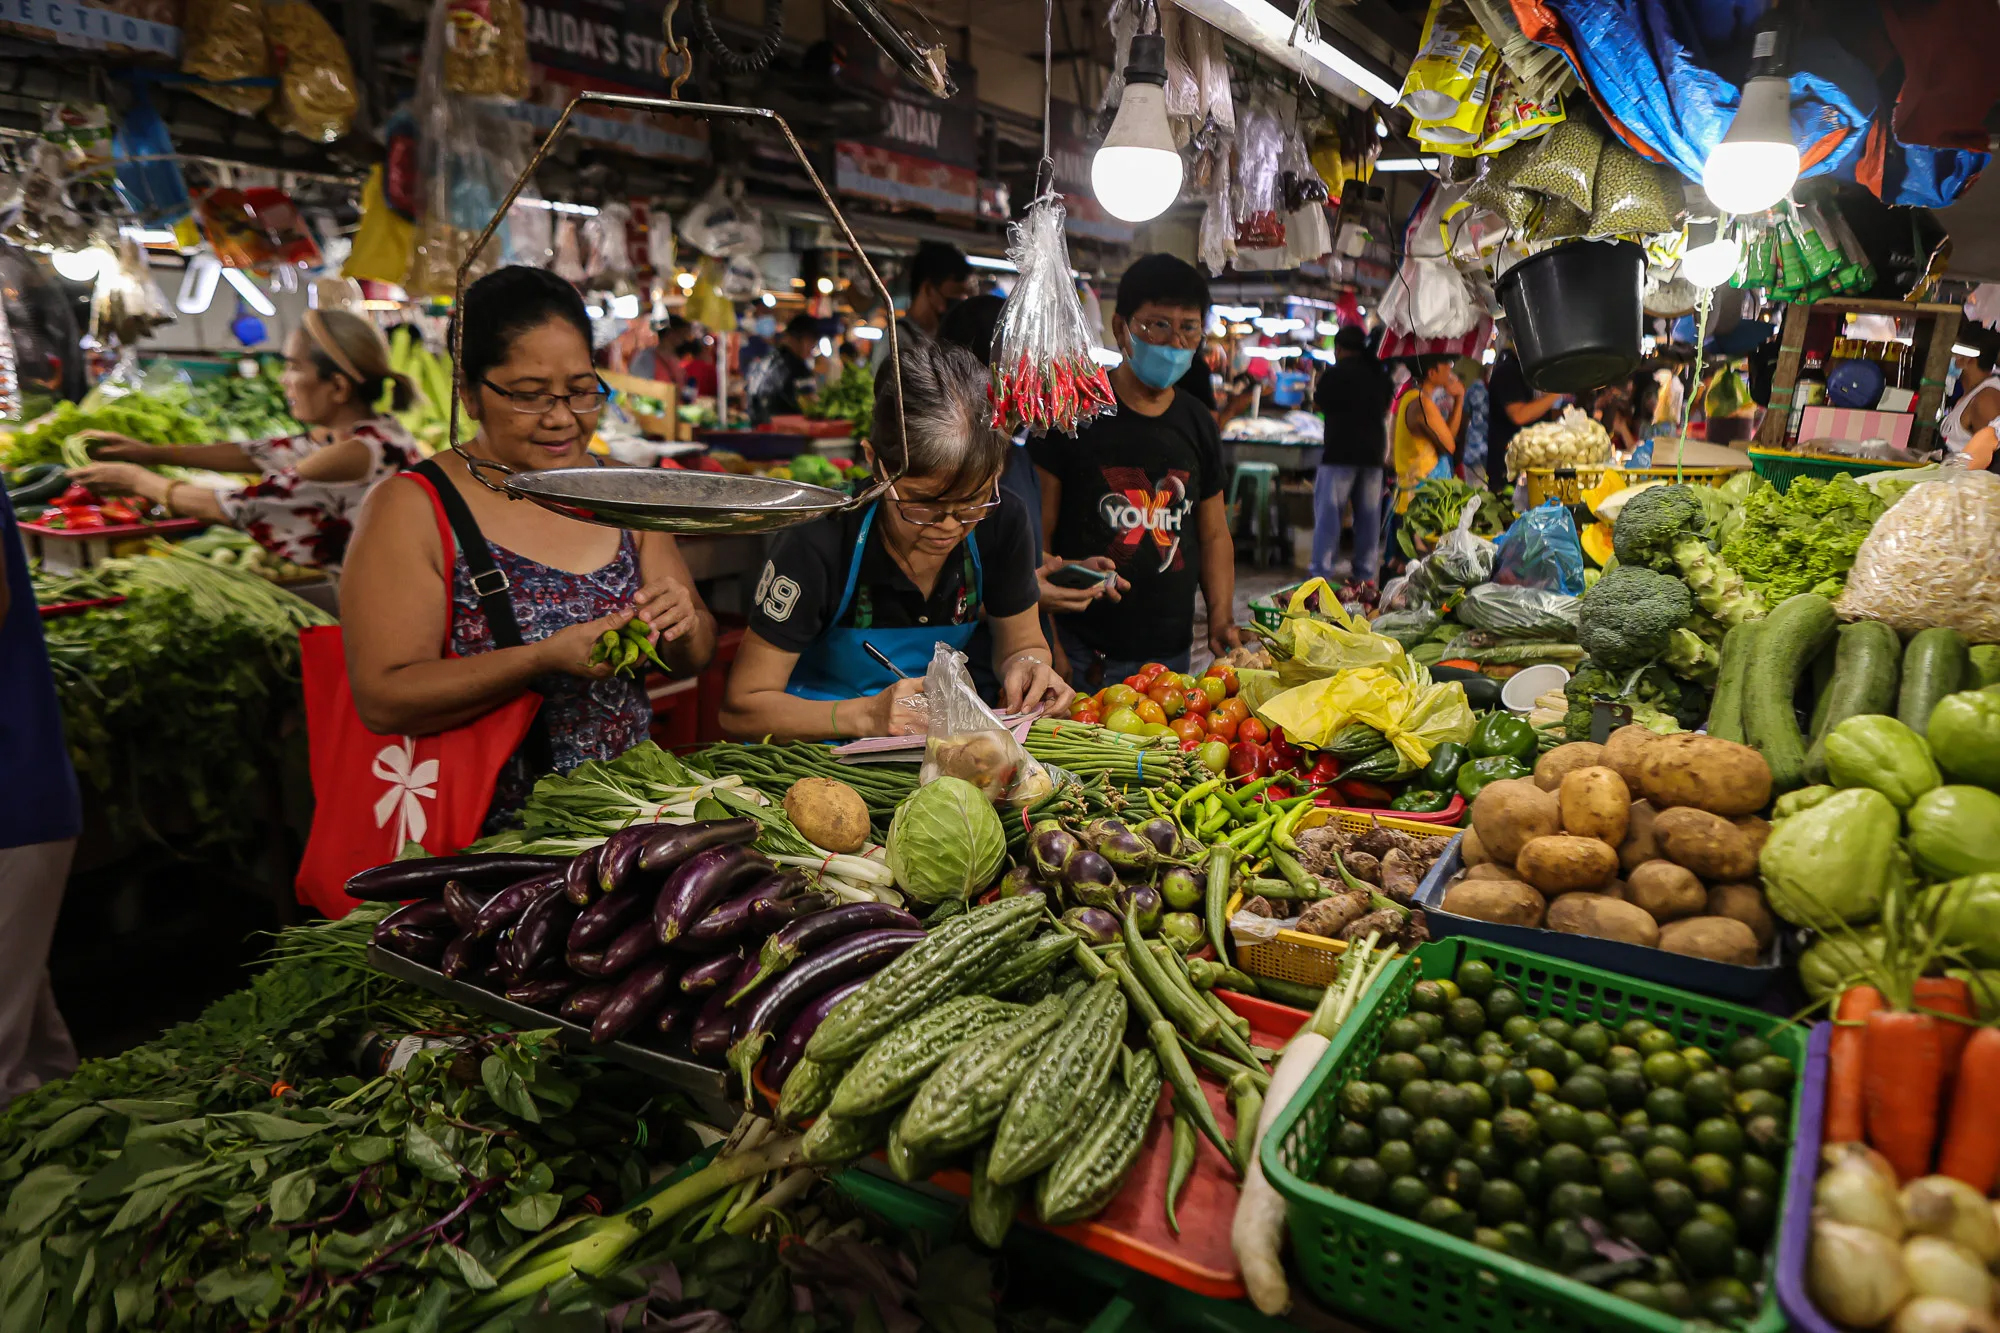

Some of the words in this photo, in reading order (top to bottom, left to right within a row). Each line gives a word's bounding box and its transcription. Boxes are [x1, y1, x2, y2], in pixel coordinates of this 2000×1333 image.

[0, 0, 166, 46] ECTION
[1105, 504, 1182, 531] YOUTH
[755, 559, 802, 623] 89
